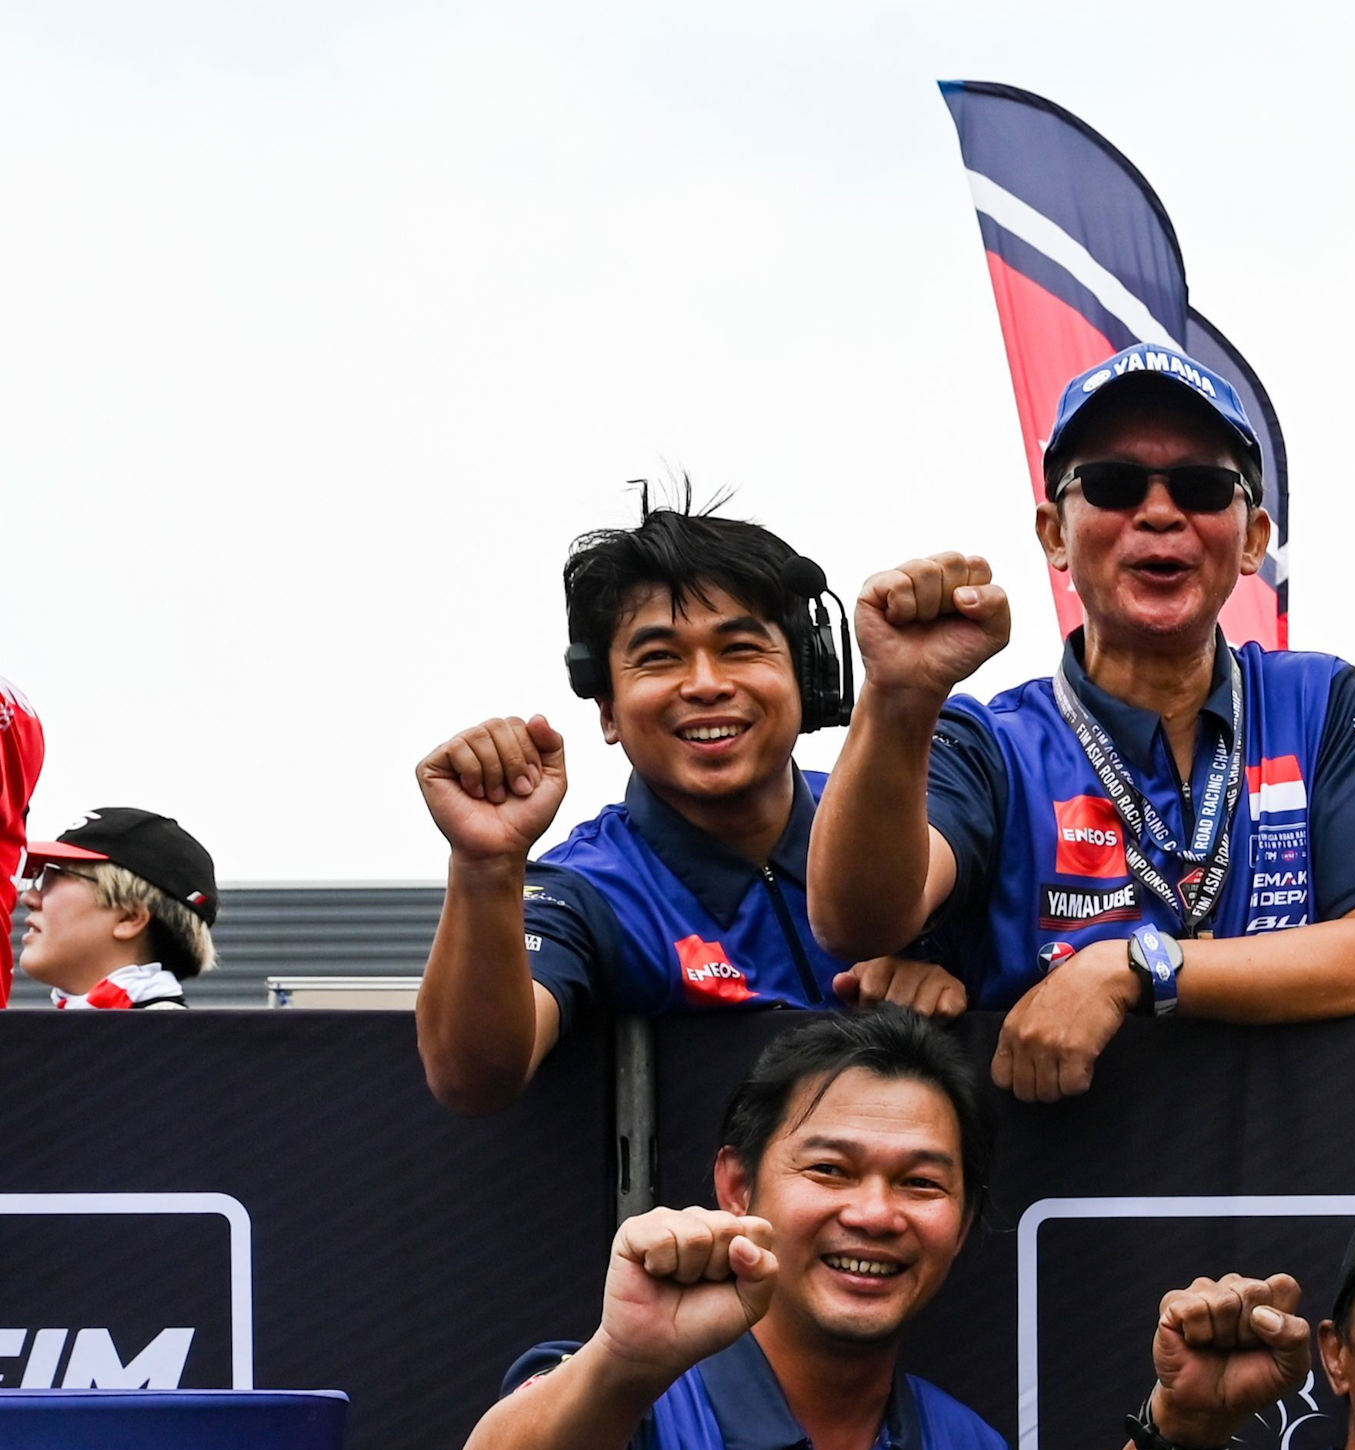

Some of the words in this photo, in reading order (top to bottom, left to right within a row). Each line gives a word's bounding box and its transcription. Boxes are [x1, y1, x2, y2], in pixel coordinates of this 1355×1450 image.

[1114, 352, 1216, 398] YAMAHA
[1086, 741, 1101, 769] ASIA
[1100, 764, 1123, 798] ROAD
[1202, 774, 1224, 820] RACING
[1063, 828, 1118, 847] ENEOS
[1195, 822, 1213, 857] ROAD
[1048, 884, 1136, 919] YAMALUBE
[1192, 896, 1210, 917] FIM
[1205, 862, 1226, 899] ASIA
[687, 960, 741, 982] ENEOS
